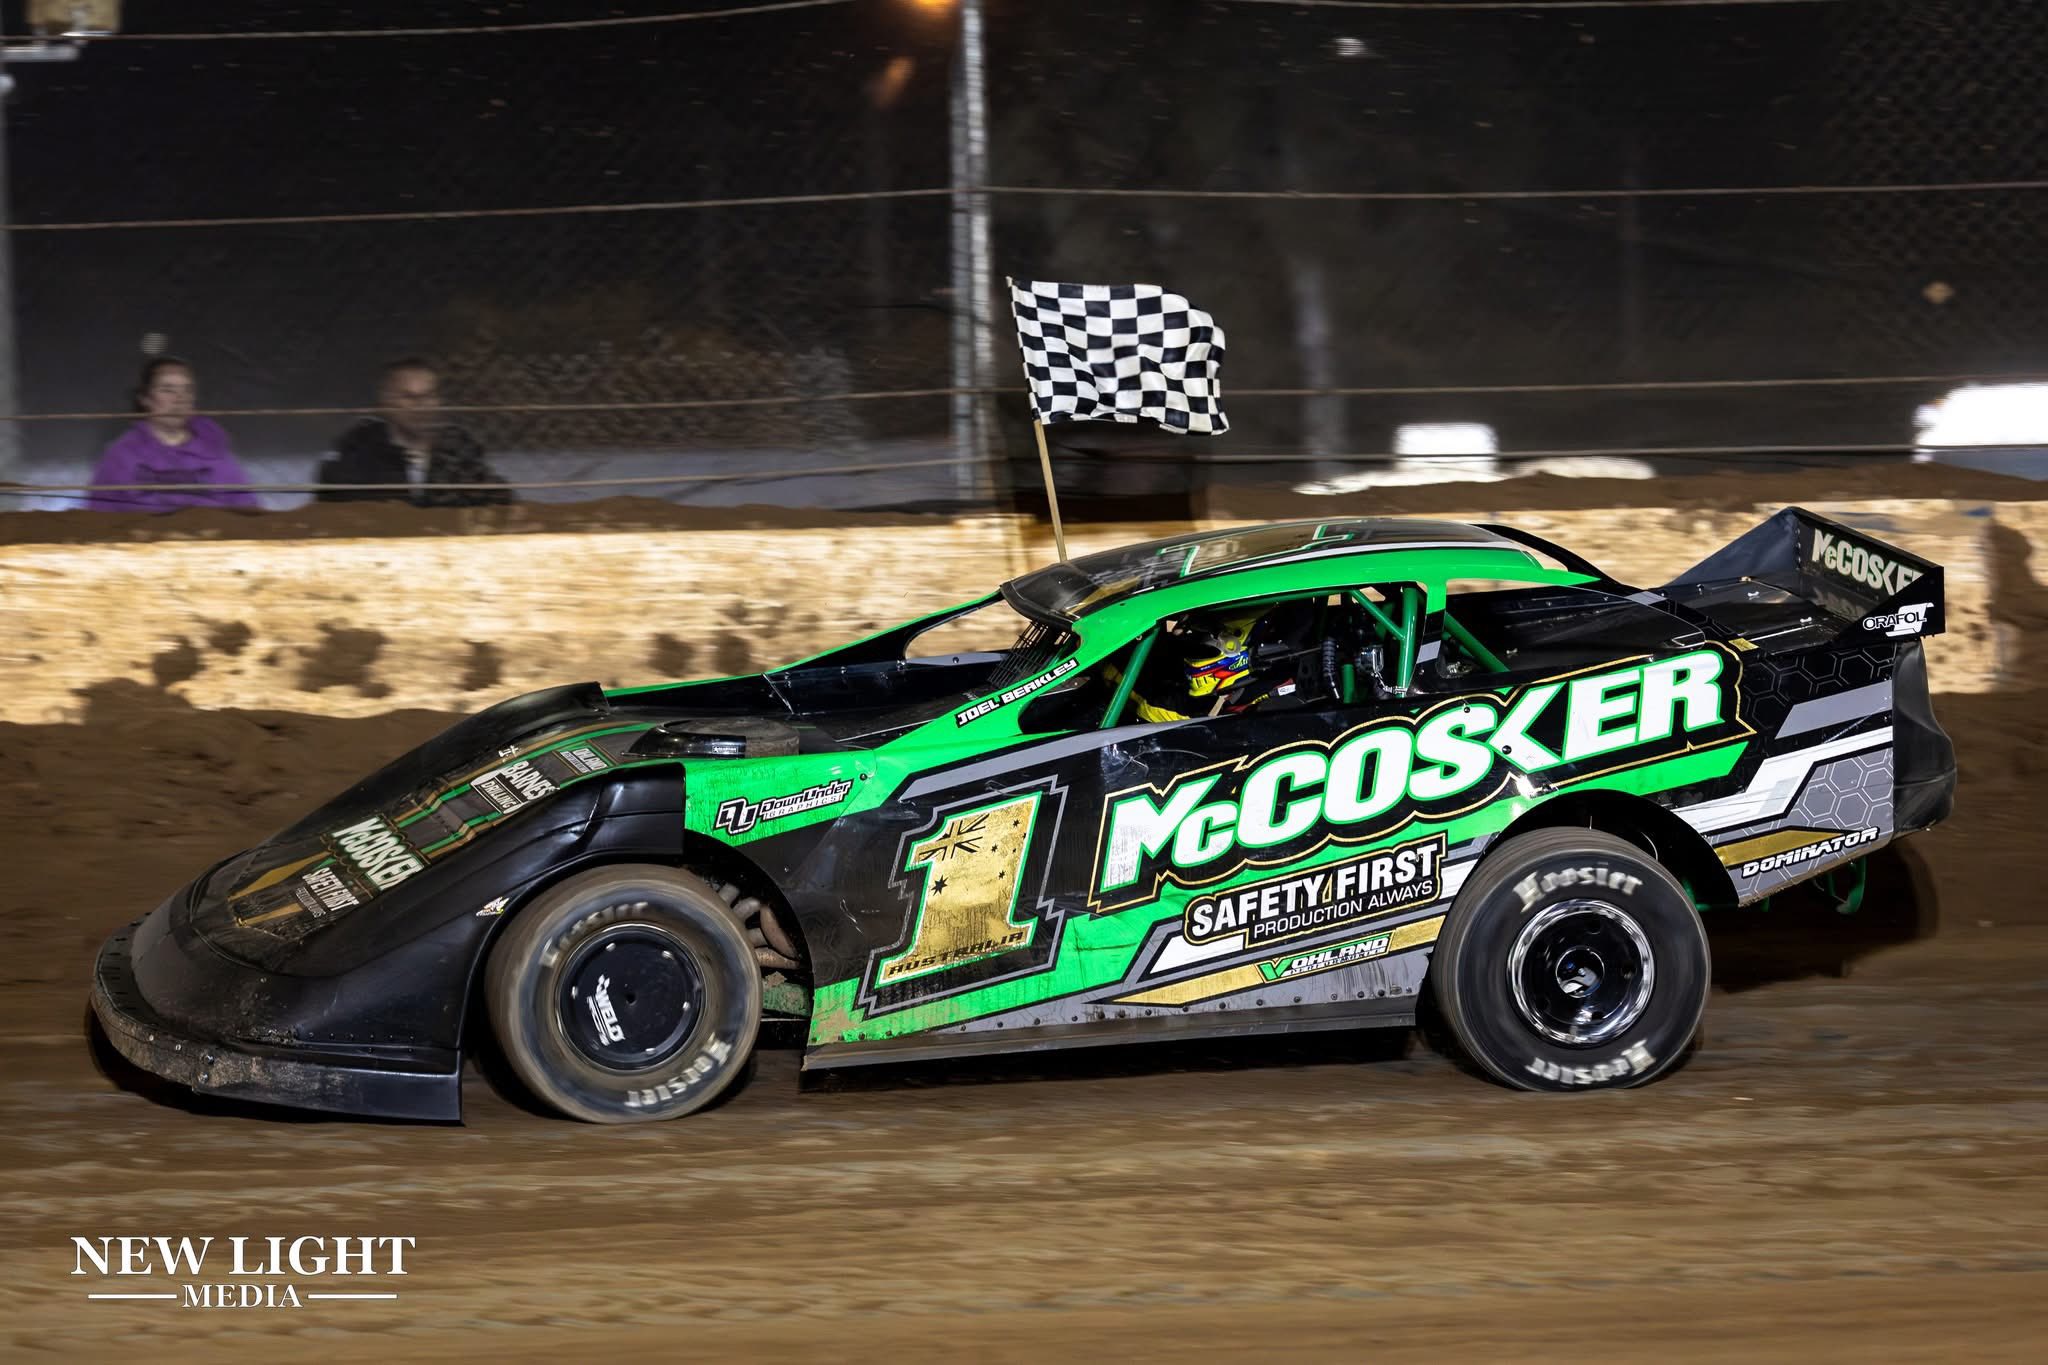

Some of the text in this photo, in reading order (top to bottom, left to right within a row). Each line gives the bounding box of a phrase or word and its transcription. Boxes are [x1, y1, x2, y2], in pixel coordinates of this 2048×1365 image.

[1811, 528, 1924, 596] McCOSKE
[1863, 612, 1926, 631] ORAFOL
[957, 659, 1078, 726] JOEL BERKLEY
[480, 780, 517, 808] DRILLING
[500, 761, 553, 800] BARNES
[1100, 649, 1725, 893] McCOSKER
[1741, 827, 1878, 878] DOMINATOR
[875, 791, 1042, 988] 1
[1192, 844, 1438, 937] SAFETY FIRST
[1253, 879, 1433, 939] PRODUCTION ALWAYS
[888, 931, 1024, 976] AUSTRALIA
